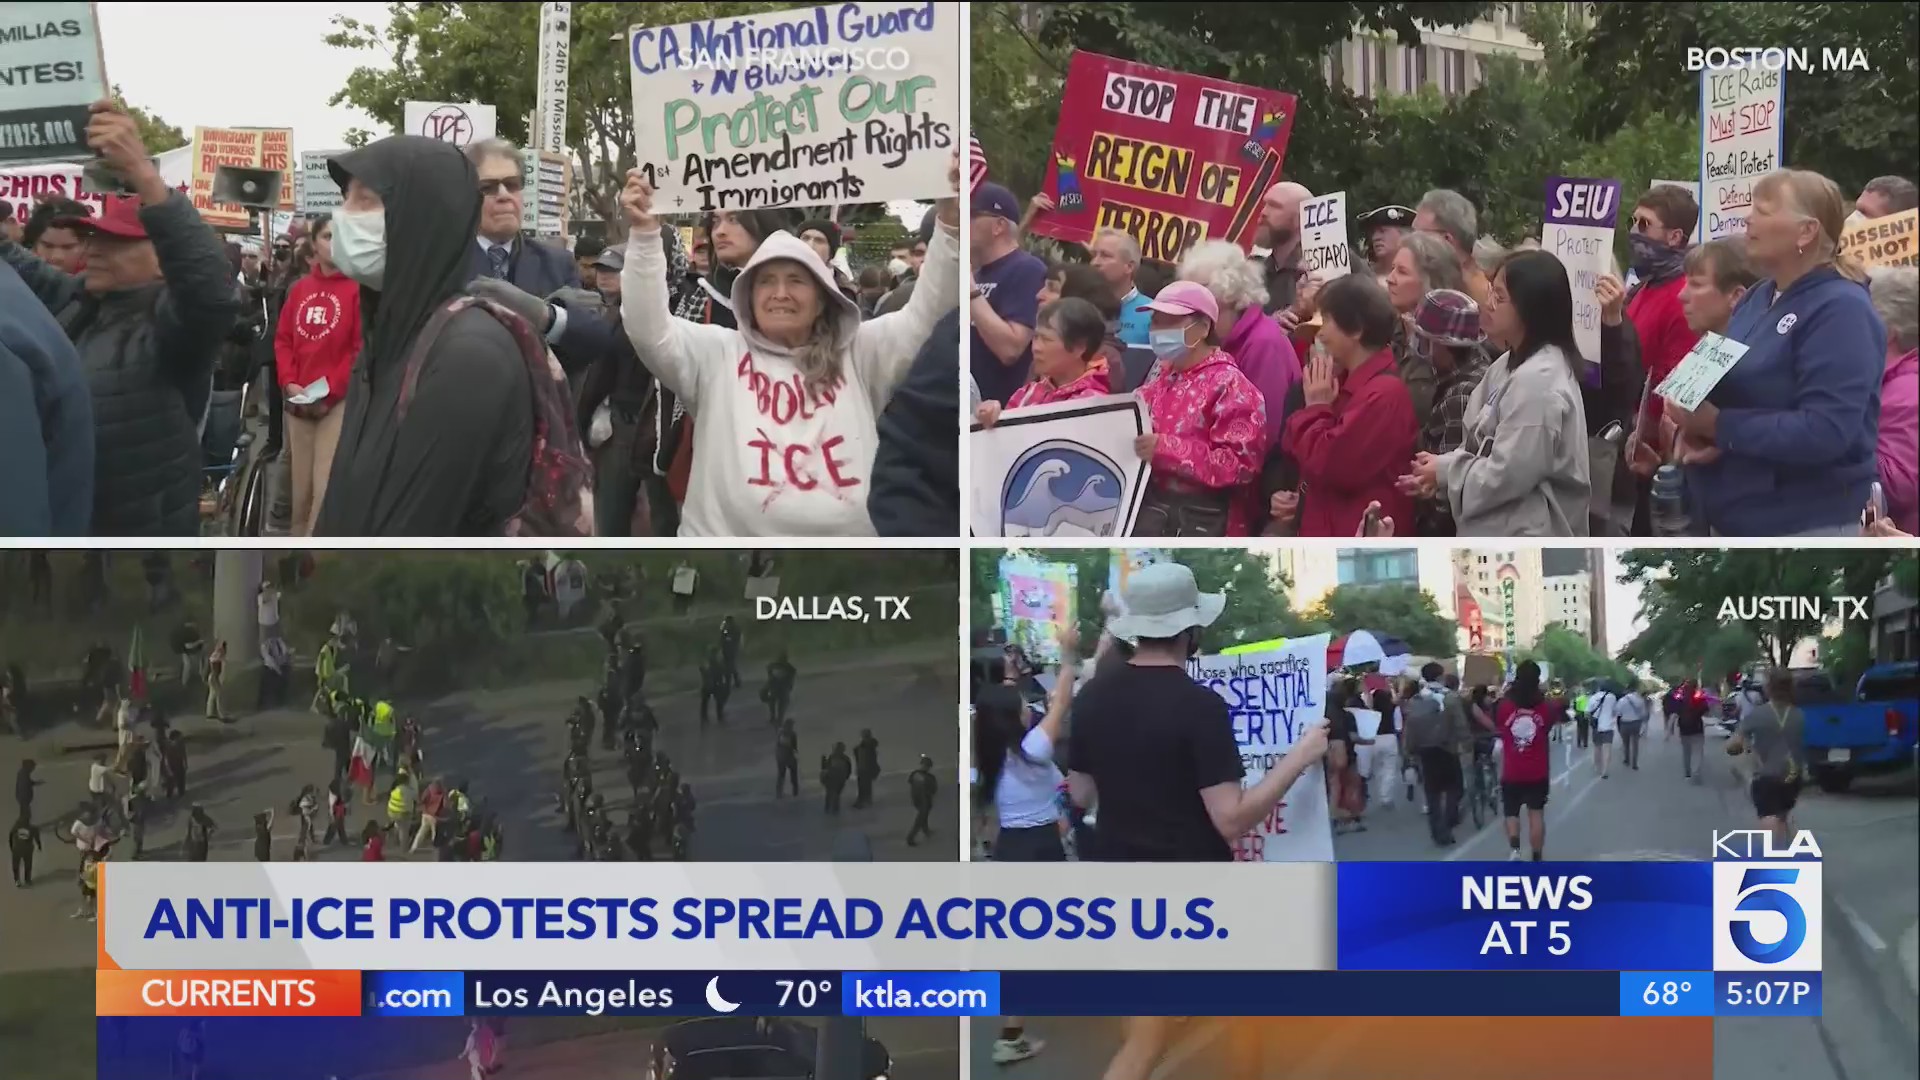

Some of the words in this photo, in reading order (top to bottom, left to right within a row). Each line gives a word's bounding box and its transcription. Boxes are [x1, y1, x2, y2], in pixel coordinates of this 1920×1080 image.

[632, 26, 683, 74] CA
[690, 7, 829, 65] National
[838, 2, 936, 42] Guard
[555, 41, 568, 74] 24th
[554, 79, 566, 93] St
[1105, 76, 1175, 120] STOP
[1200, 89, 1256, 133] THE
[1710, 74, 1736, 103] ICE
[1739, 68, 1779, 99] Raids
[203, 130, 257, 144] IMMIGRANT
[552, 98, 566, 153] Mission
[664, 84, 824, 161] Protect
[839, 75, 936, 123] Our
[1709, 109, 1736, 139] Must
[1740, 100, 1776, 131] STOP
[201, 144, 218, 154] AND
[219, 144, 256, 156] WORKERS
[641, 162, 671, 190] 1st
[683, 127, 858, 186] Amendment
[865, 112, 951, 168] Rights
[1087, 134, 1193, 195] REIGN
[1200, 164, 1239, 203] OF
[1706, 151, 1738, 178] Peaceful
[1740, 148, 1775, 176] Protest
[696, 169, 865, 211] Immigrants
[1552, 183, 1615, 220] SEIU
[1304, 199, 1338, 229] ICE
[1869, 237, 1910, 261] NOT
[747, 435, 862, 491] ICE
[1229, 654, 1256, 677] who
[1260, 653, 1310, 675] sacrifice
[1193, 670, 1317, 710] SENTIAL
